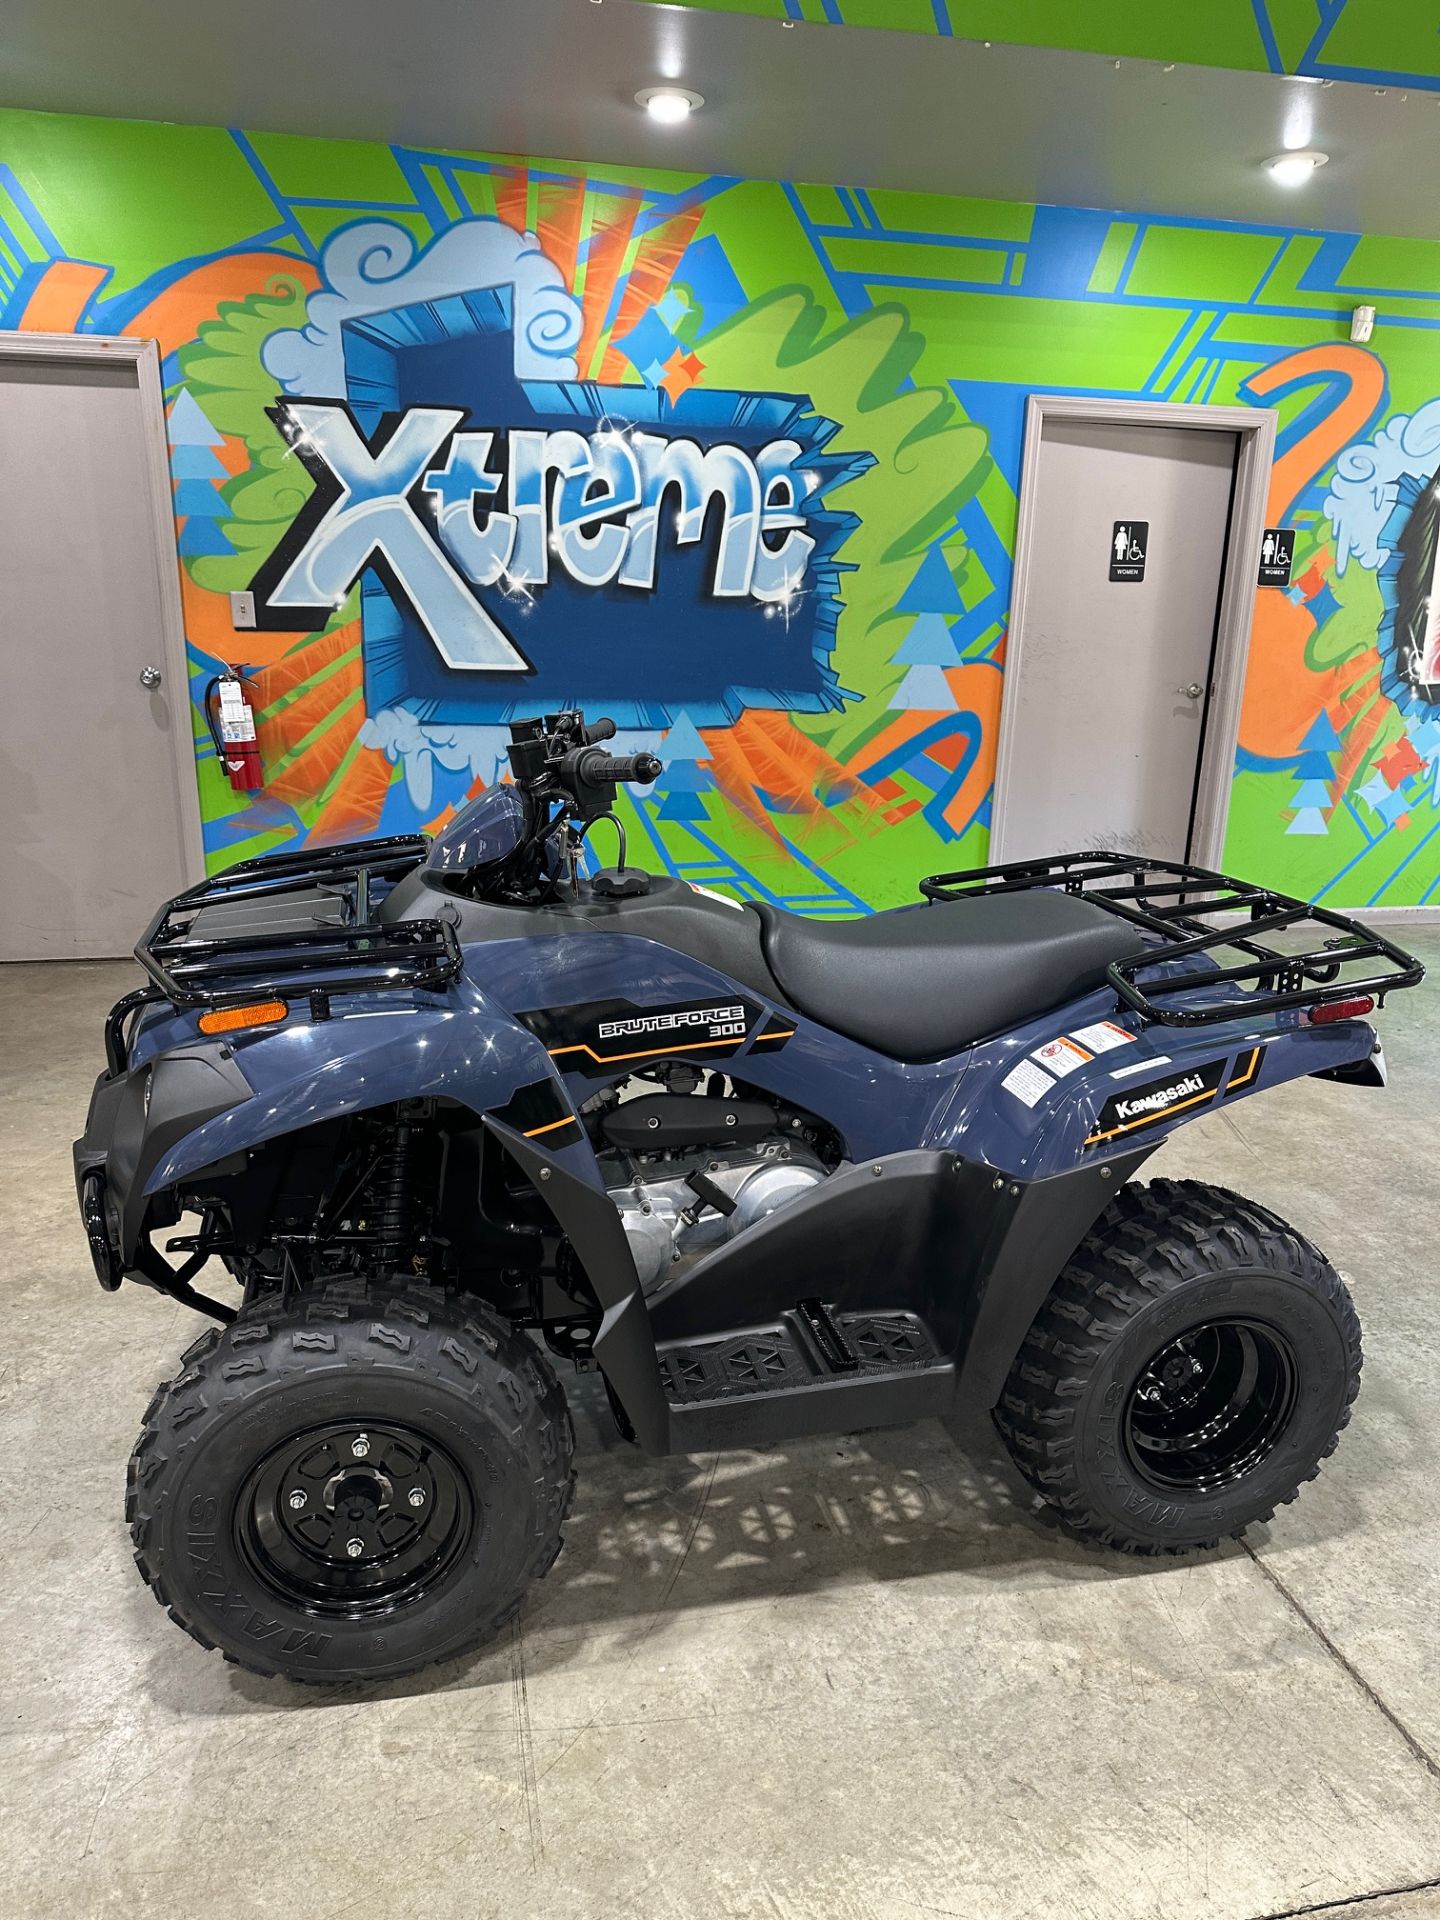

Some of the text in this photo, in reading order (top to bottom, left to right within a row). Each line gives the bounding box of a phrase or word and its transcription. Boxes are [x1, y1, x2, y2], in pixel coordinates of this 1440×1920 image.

[264, 402, 817, 671] Xtreme
[1264, 568, 1285, 576] WOMEN
[709, 1022, 746, 1037] 300
[1114, 1073, 1205, 1119] Kawasaki
